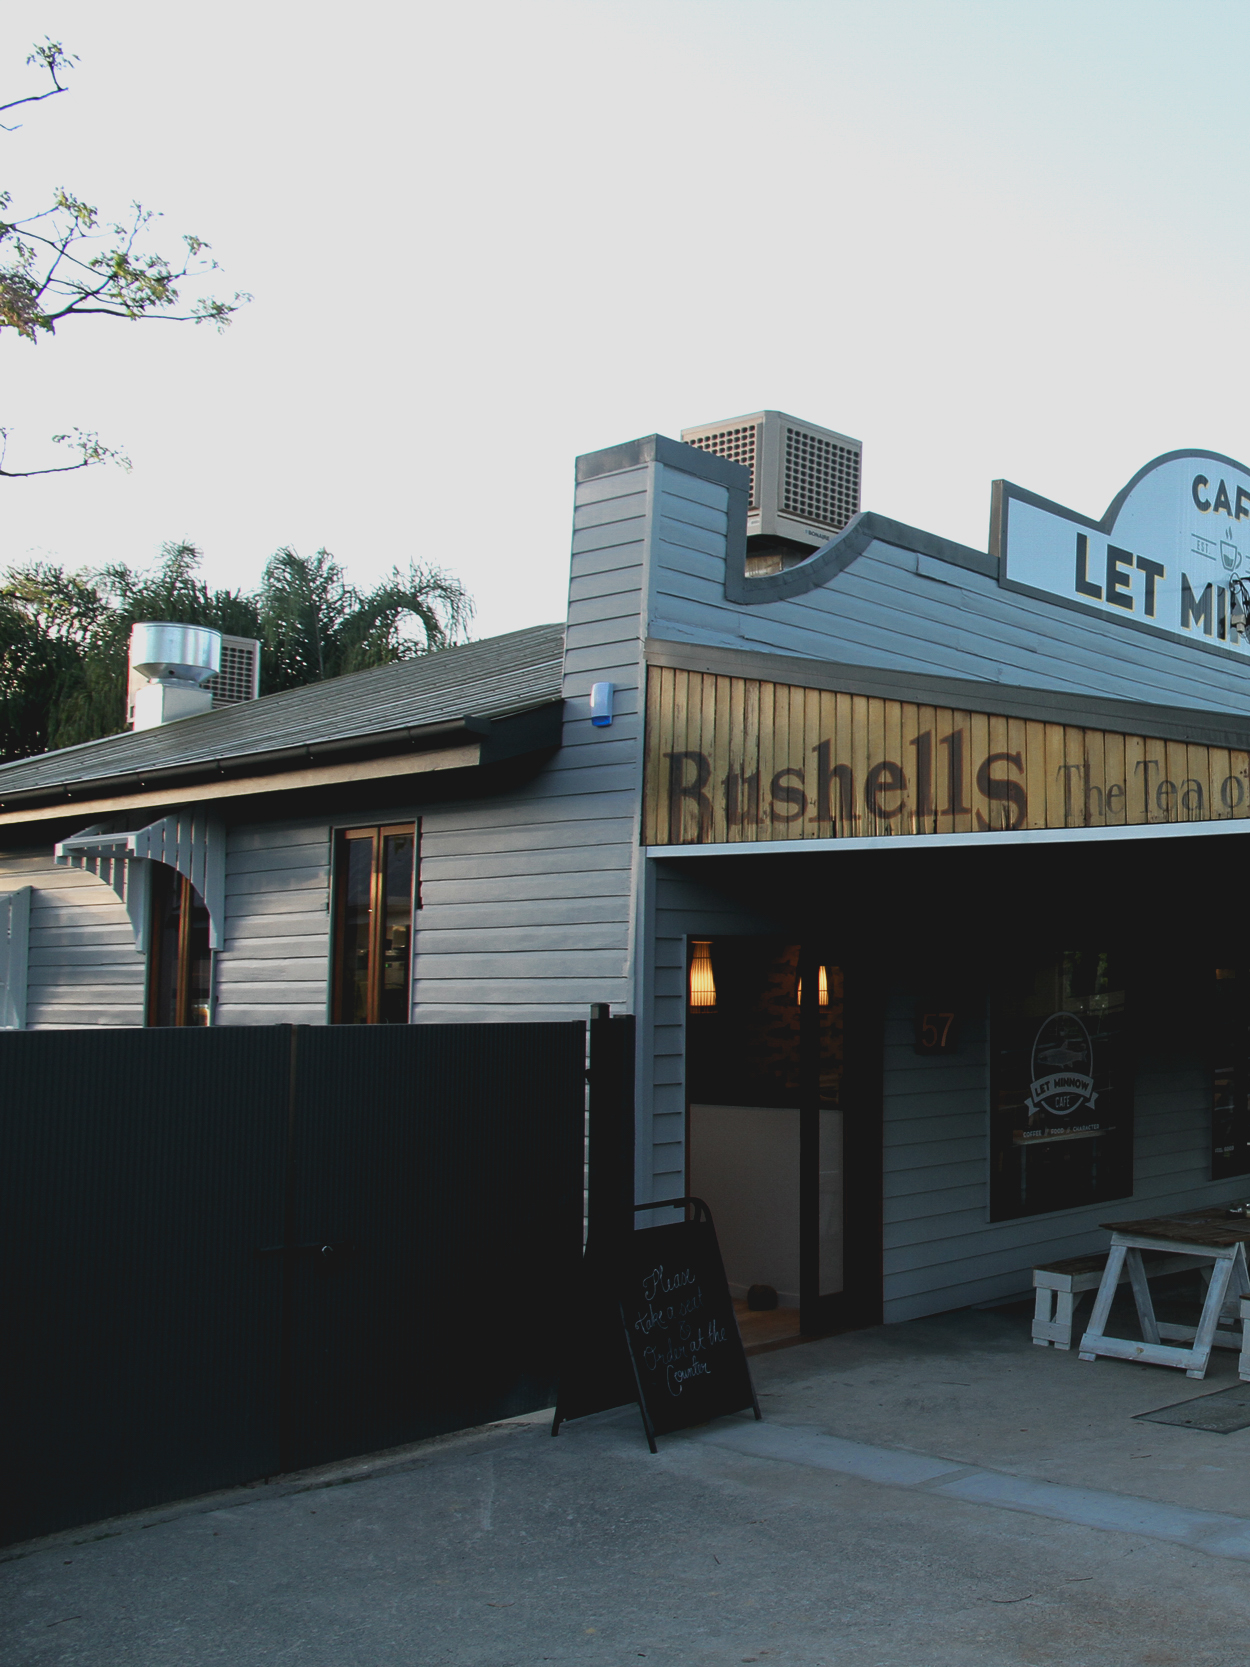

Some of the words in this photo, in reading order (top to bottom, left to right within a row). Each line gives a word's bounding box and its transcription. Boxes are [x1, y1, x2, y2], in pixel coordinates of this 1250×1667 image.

[1196, 539, 1211, 554] EST.
[1075, 532, 1165, 619] LET
[1055, 757, 1125, 822] The
[1133, 759, 1206, 815] Tea
[921, 1012, 955, 1047] 57
[1034, 1081, 1051, 1097] LET
[1053, 1077, 1090, 1092] MINNOW
[1054, 1095, 1070, 1108] CAFE
[1023, 1129, 1042, 1138] COFFEE
[1050, 1127, 1065, 1135] FOOD
[1072, 1123, 1100, 1132] CHARACTER
[642, 1264, 696, 1301] Please
[679, 1285, 704, 1316] seat
[690, 1328, 707, 1352] at
[707, 1319, 728, 1346] the
[667, 1355, 712, 1397] Counter
